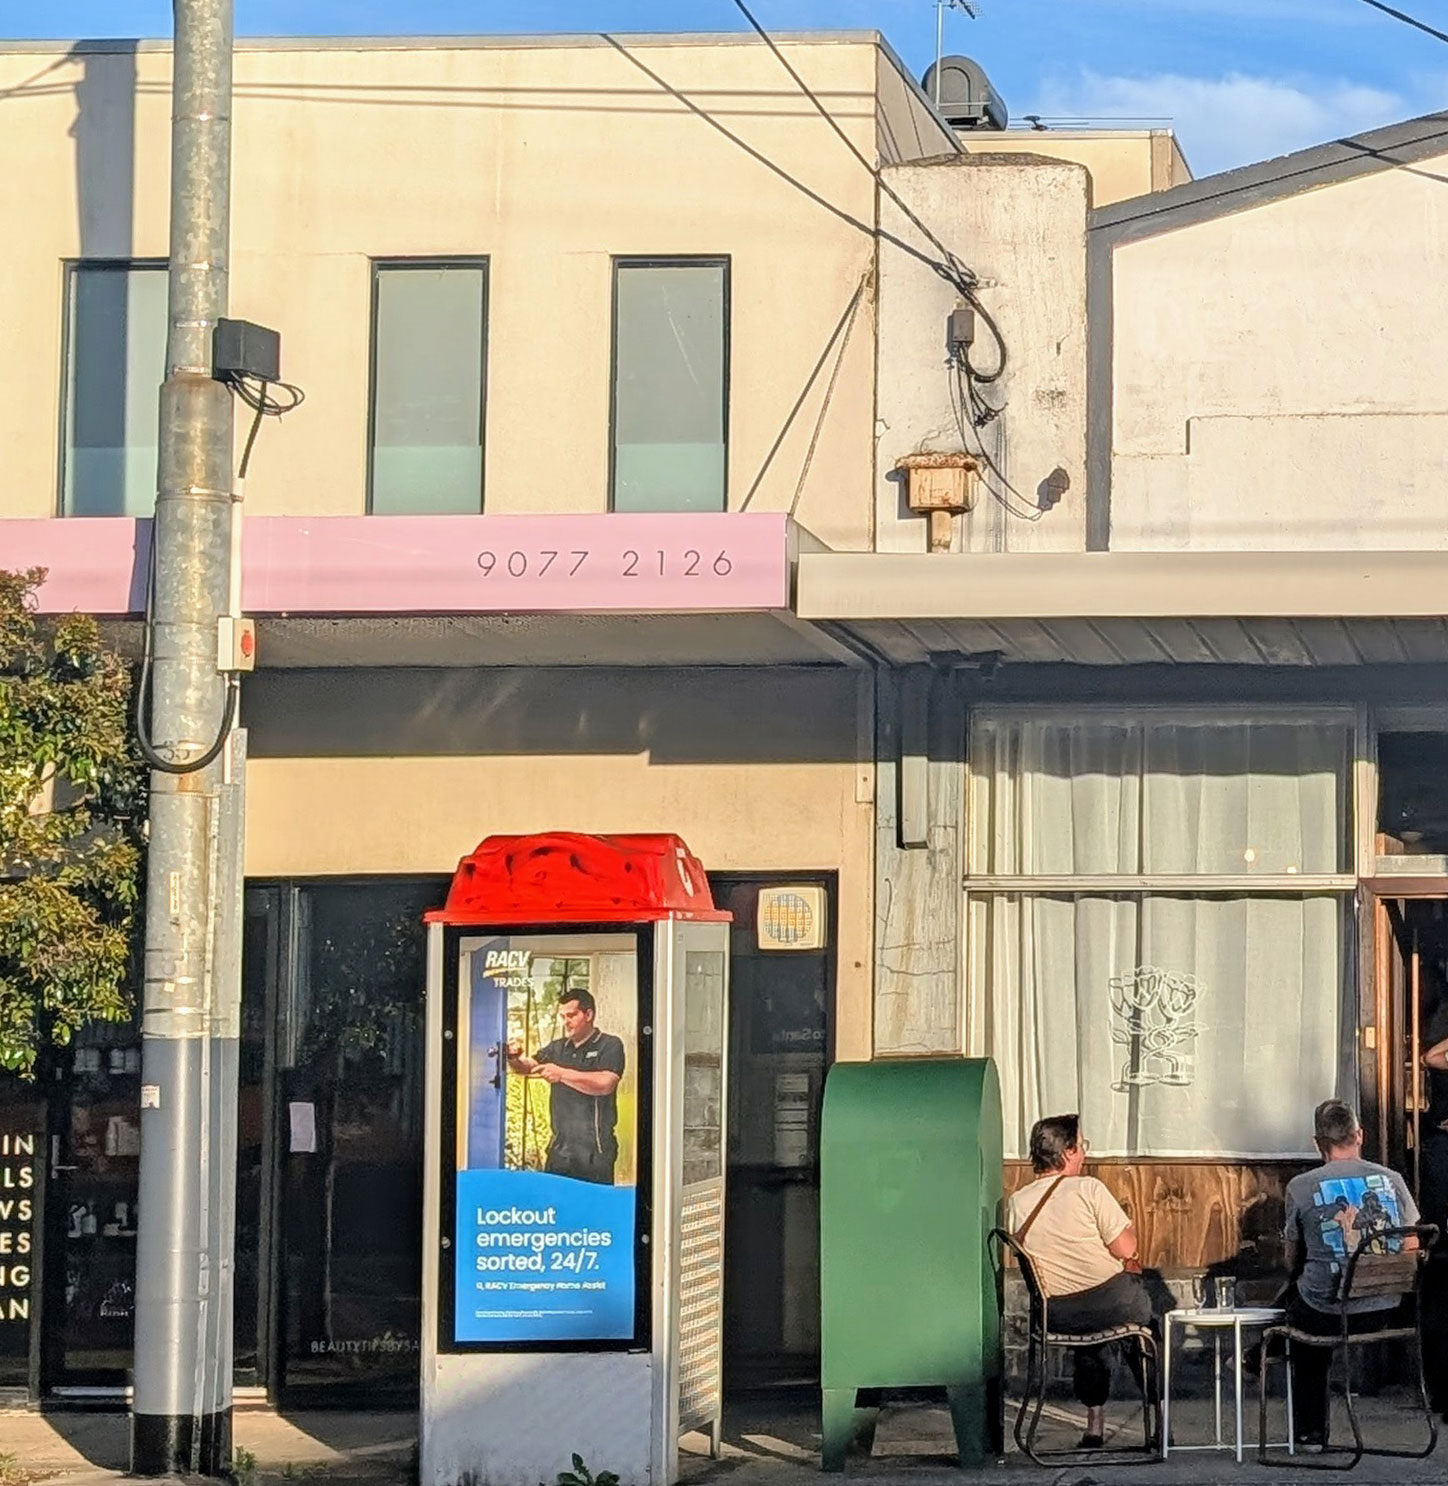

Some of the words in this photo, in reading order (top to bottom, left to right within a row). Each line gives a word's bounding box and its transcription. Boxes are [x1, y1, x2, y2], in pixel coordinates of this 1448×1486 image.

[477, 550, 589, 578] 9077
[622, 549, 732, 577] 2126
[485, 950, 531, 968] RACV
[493, 977, 535, 988] TRADES
[4, 1166, 33, 1188] LS
[476, 1207, 556, 1225] Lockout
[476, 1228, 612, 1252] emergencies
[476, 1253, 546, 1273] sorted,
[550, 1248, 600, 1273] 24/7.
[509, 1281, 555, 1292] Emergency
